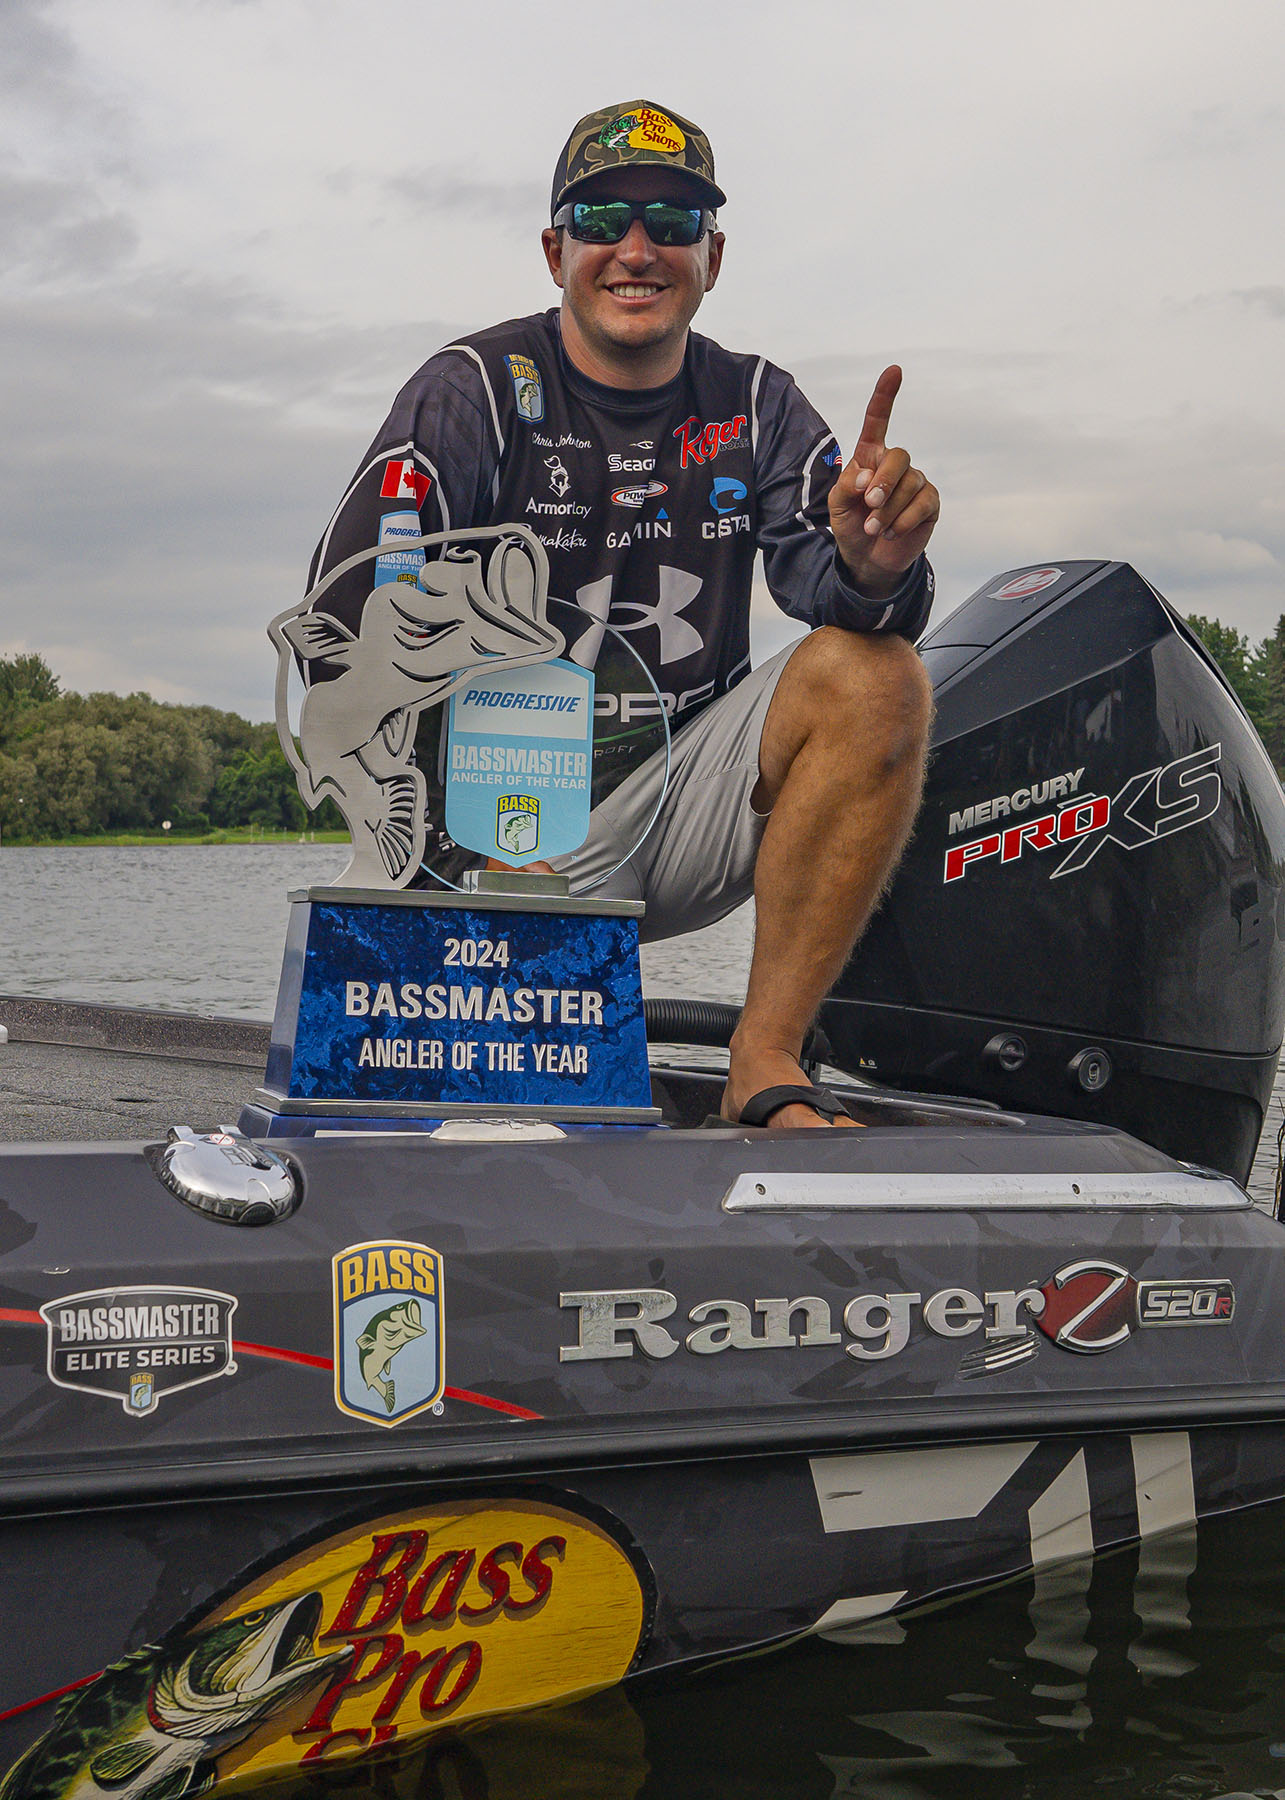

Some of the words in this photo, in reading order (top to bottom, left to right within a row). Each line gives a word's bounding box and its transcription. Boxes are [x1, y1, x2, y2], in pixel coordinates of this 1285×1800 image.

[638, 109, 673, 127] Bass
[642, 119, 666, 134] Pro
[641, 130, 682, 151] Shops
[462, 689, 582, 713] PROGRESSIVE
[451, 744, 587, 777] BASSMASTER
[451, 772, 503, 785] ANGLER
[506, 775, 523, 786] OF
[525, 776, 550, 788] THE
[553, 778, 587, 790] YEAR
[948, 767, 1086, 835] MERCURY
[943, 795, 1111, 884] PRO
[443, 938, 510, 968] 2024
[345, 981, 604, 1026] BASSMASTER
[358, 1038, 444, 1070] ANGLER
[452, 1041, 479, 1071] OF
[485, 1042, 525, 1073] THE
[531, 1043, 589, 1074] YEAR
[60, 1303, 220, 1343] BASSMASTER
[559, 1287, 1046, 1366] Ranger
[66, 1350, 130, 1372] ELITE
[136, 1345, 217, 1368] SERIES
[318, 1528, 568, 1642] Bass
[292, 1632, 484, 1738] Pro
